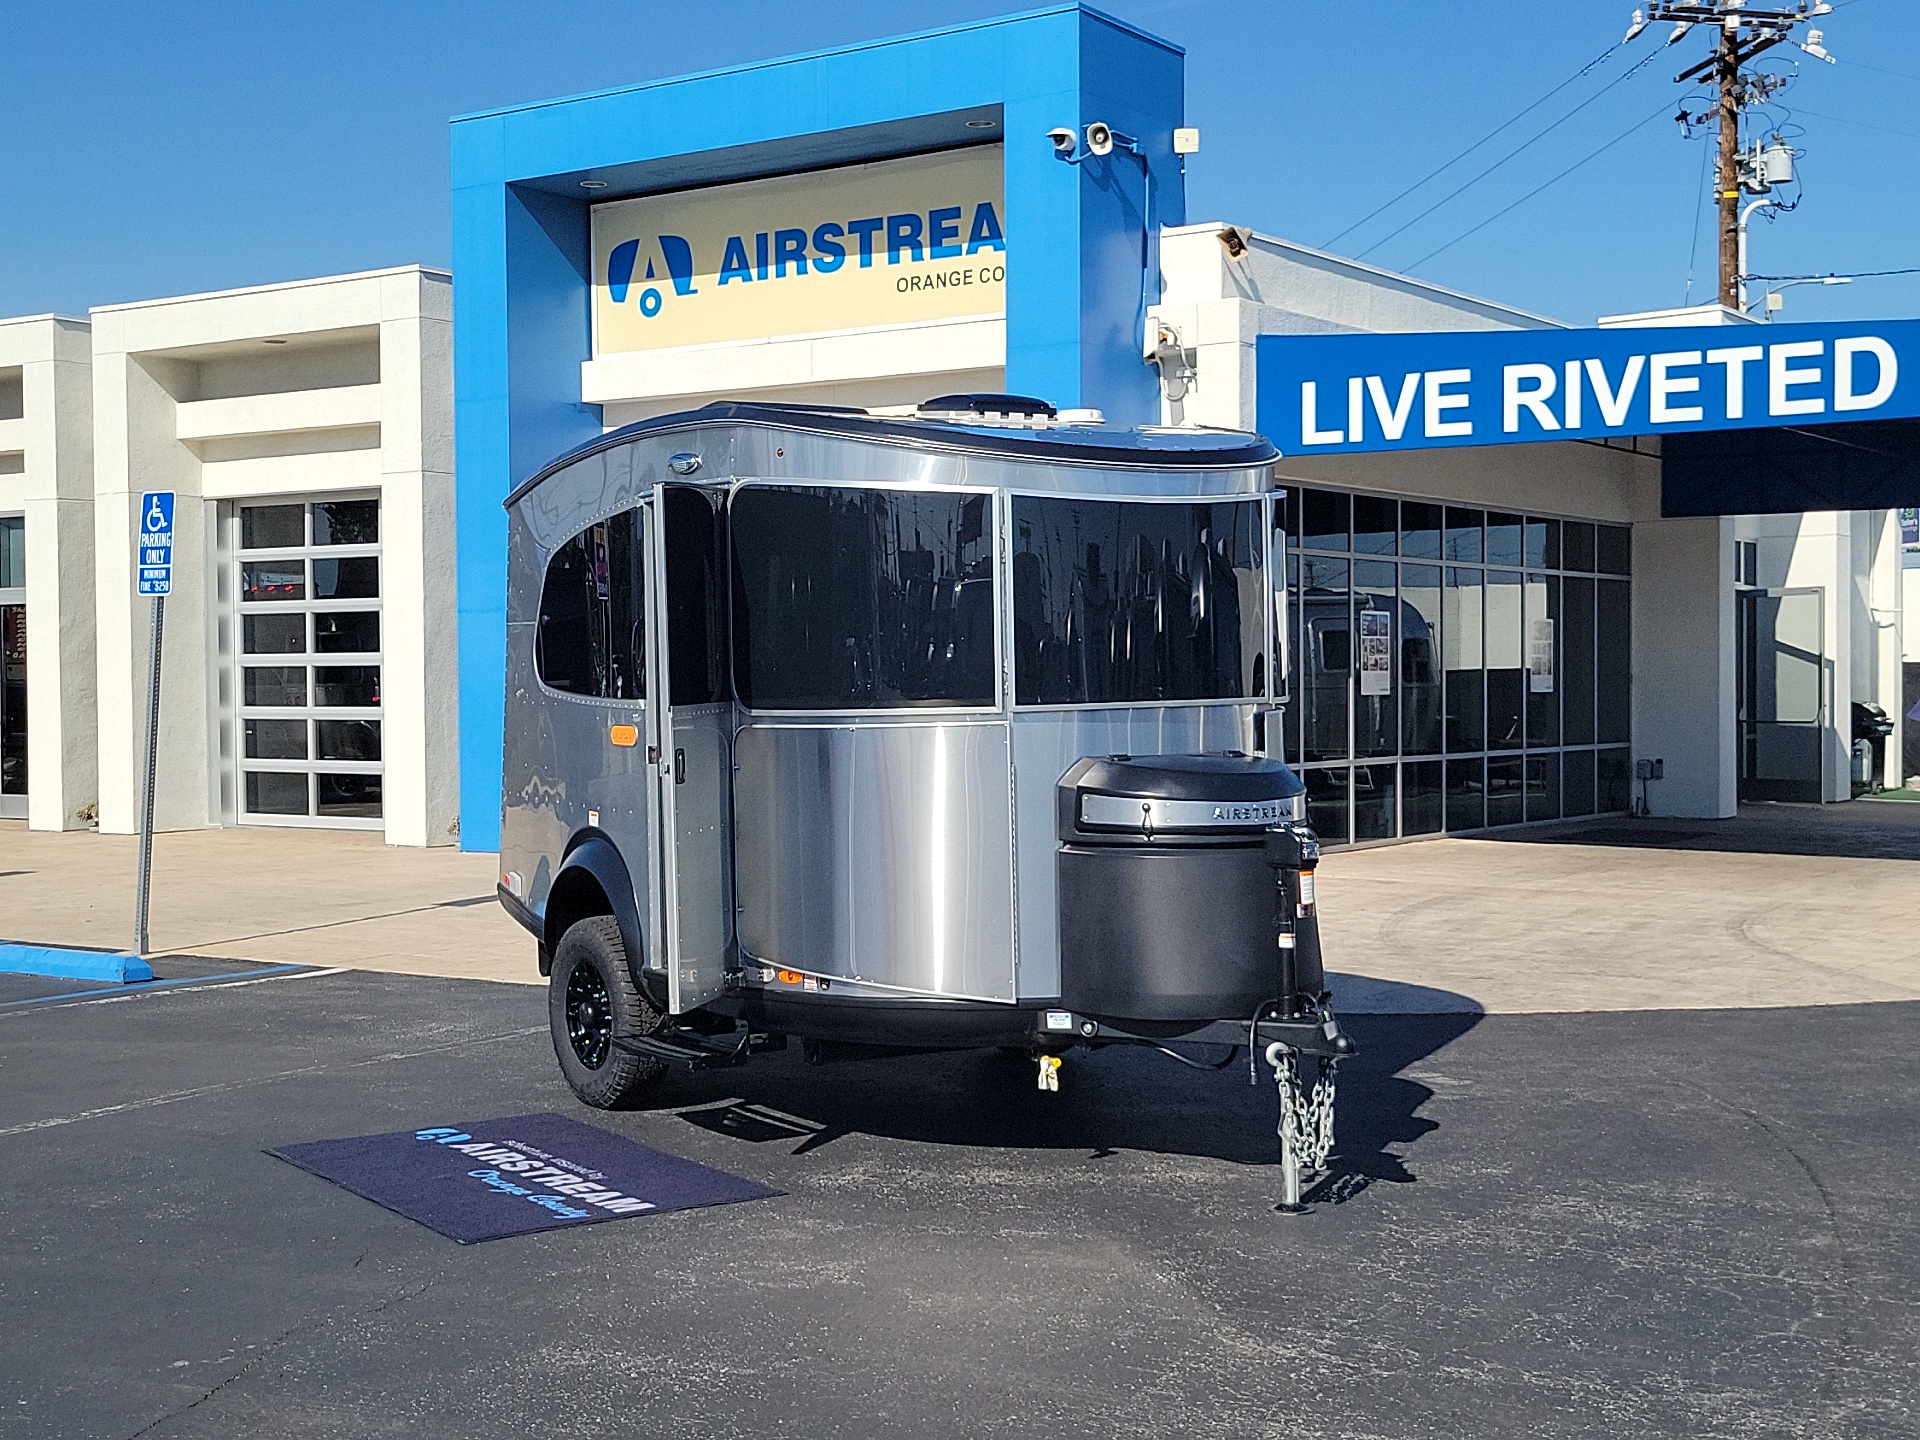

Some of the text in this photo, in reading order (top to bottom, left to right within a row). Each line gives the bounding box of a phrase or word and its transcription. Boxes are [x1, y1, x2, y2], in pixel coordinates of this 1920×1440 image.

[896, 269, 974, 293] ORANGE
[1301, 336, 1899, 446] LIVE RIVETED
[141, 532, 171, 547] PARKING
[146, 549, 165, 563] ONLY
[140, 580, 152, 591] FINE
[449, 1141, 657, 1214] AIRSTREAM
[466, 1168, 592, 1220] Orange County
